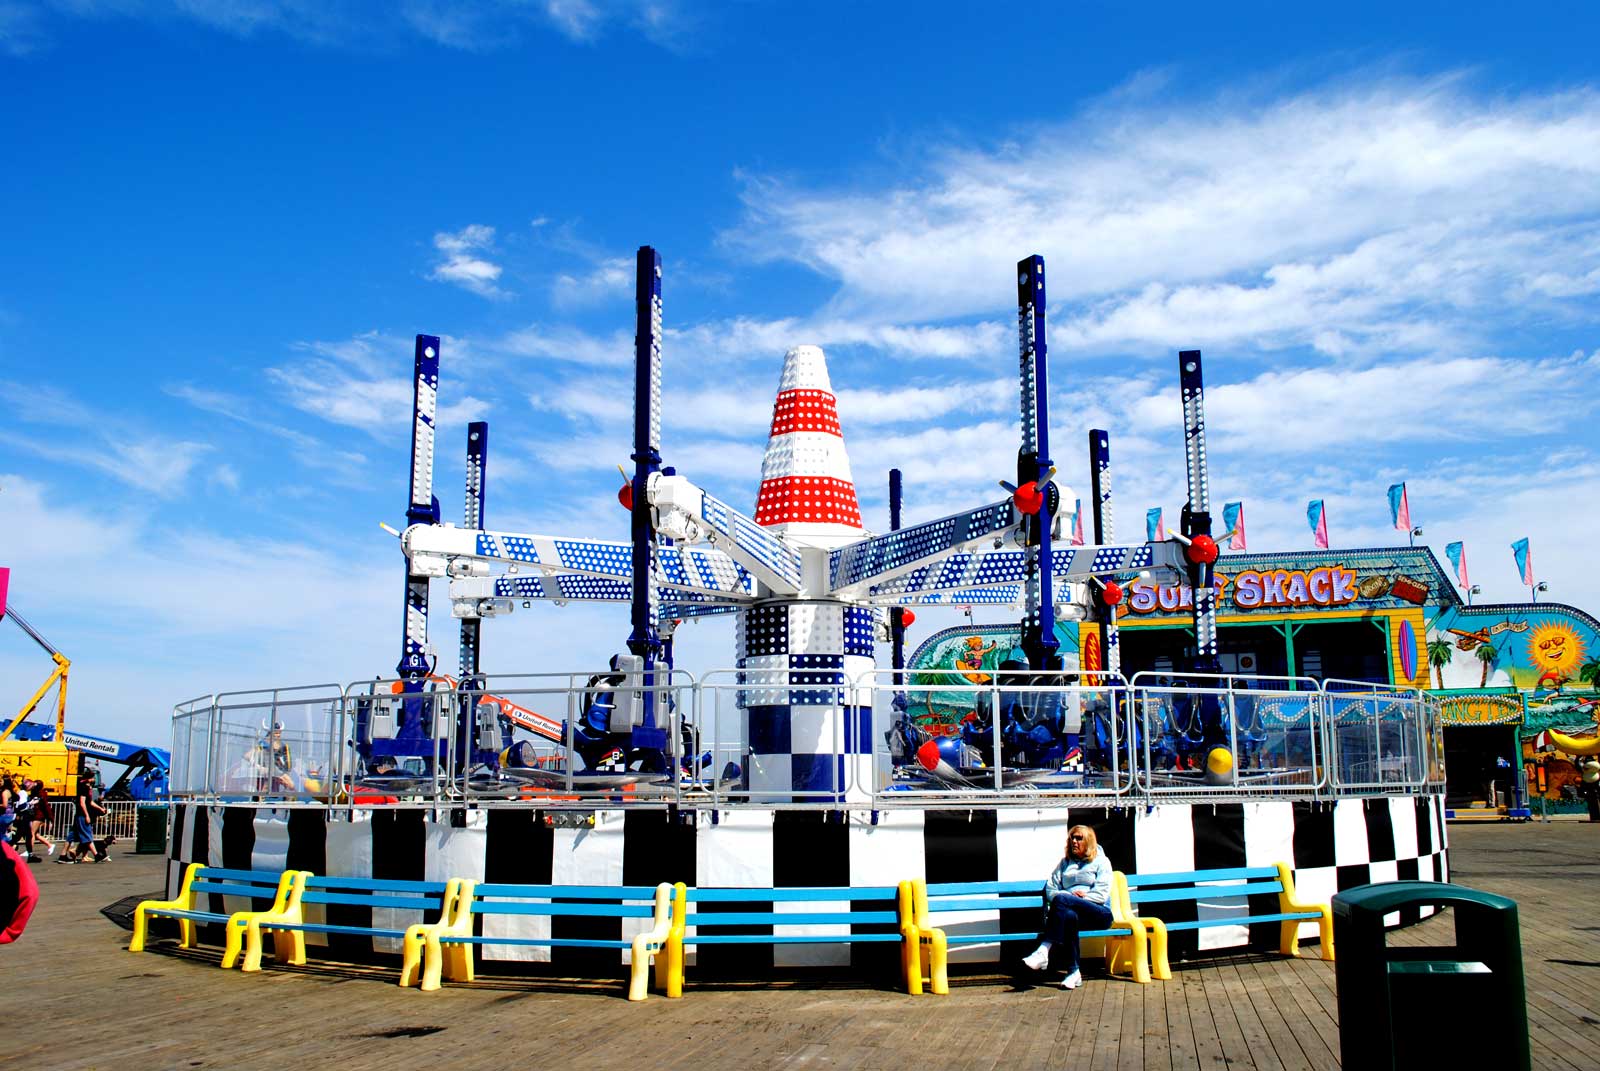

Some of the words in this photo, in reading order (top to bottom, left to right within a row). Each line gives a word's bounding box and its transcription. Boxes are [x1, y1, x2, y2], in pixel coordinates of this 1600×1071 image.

[65, 736, 89, 748] United
[89, 741, 116, 753] Rentals
[17, 754, 32, 767] K
